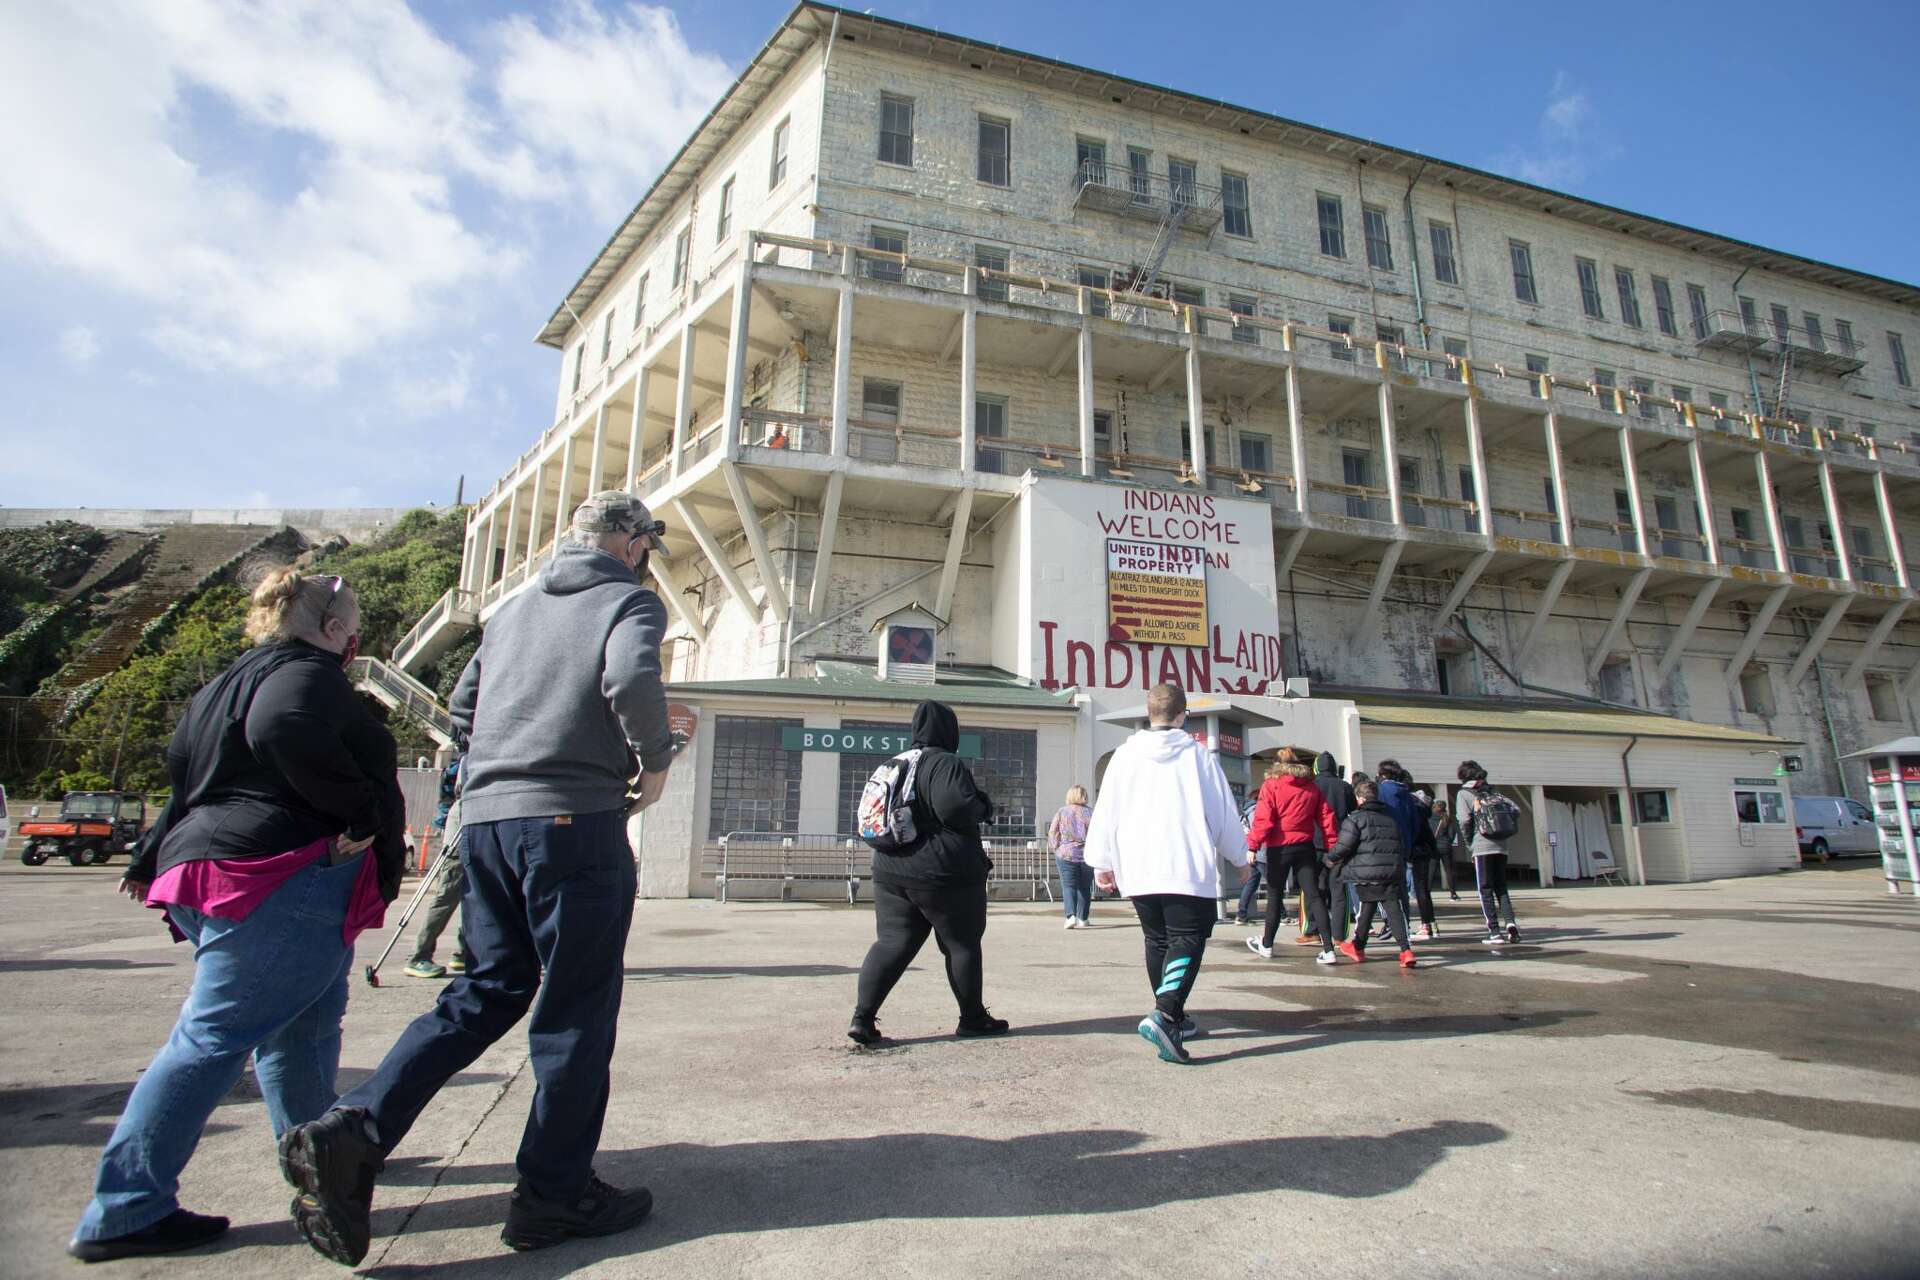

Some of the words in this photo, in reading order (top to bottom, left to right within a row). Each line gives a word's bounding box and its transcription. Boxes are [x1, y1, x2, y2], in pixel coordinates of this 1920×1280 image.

[1124, 490, 1216, 519] INDIANS
[1097, 510, 1240, 544] WELCOME
[1109, 543, 1155, 557] UNITED
[1158, 544, 1230, 569] INDIAN
[1118, 557, 1194, 574] PROPERTY
[1110, 572, 1140, 583] ALCATRAZ
[1142, 574, 1162, 585] ISLAND
[1163, 576, 1178, 586] AREA
[1185, 578, 1204, 588] ACRES
[1120, 583, 1138, 592] MILES
[1139, 584, 1147, 593] TO
[1148, 585, 1182, 596] TRANSPORT
[1184, 588, 1200, 597] DOCK
[1144, 619, 1174, 630] ALLOWED
[1175, 621, 1200, 632] ASHORE
[1133, 629, 1160, 640] WITHOUT
[1162, 631, 1167, 640] A
[1168, 632, 1186, 641] PASS
